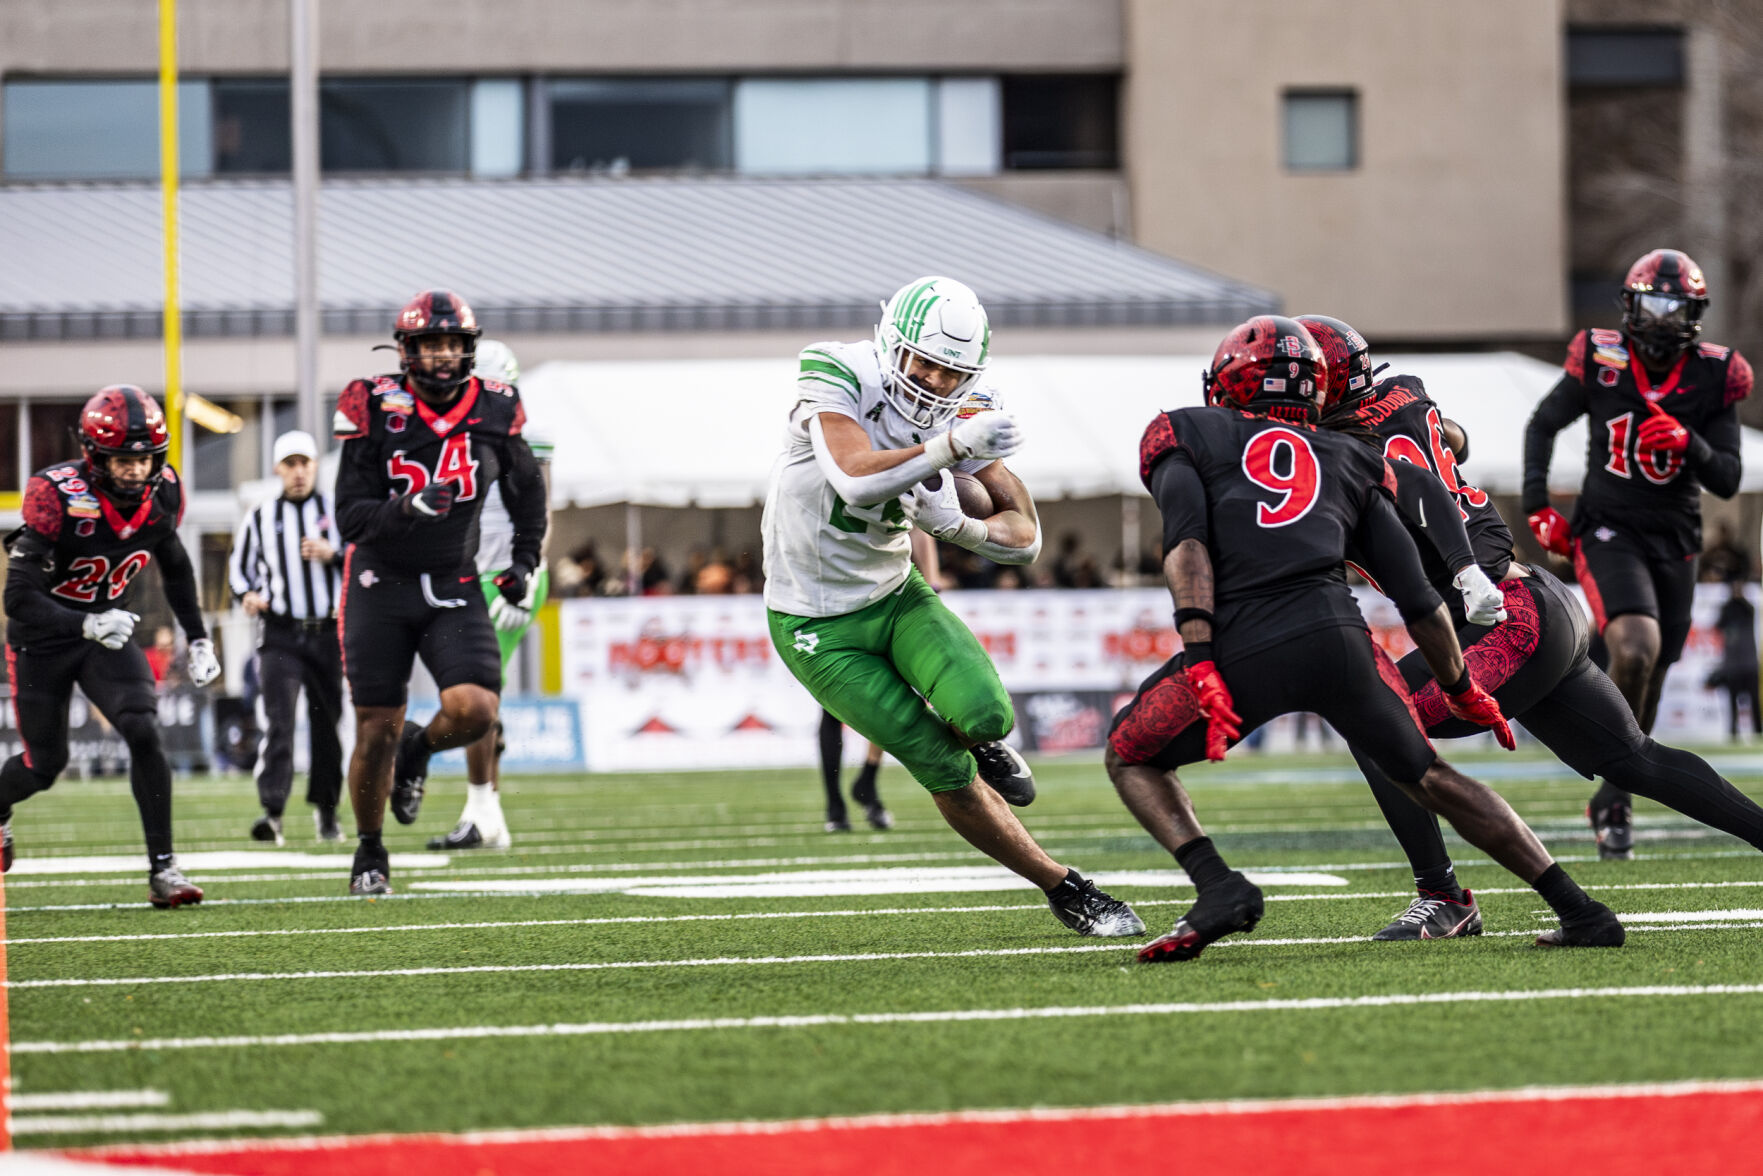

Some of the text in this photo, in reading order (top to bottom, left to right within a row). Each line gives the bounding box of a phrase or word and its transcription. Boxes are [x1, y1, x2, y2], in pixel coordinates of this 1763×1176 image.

[943, 347, 962, 359] UNT
[1289, 362, 1300, 379] 9
[1269, 405, 1309, 420] AZTECS
[1604, 411, 1686, 485] 10
[45, 466, 89, 496] 29
[386, 431, 480, 503] 54
[1241, 426, 1321, 528] 9
